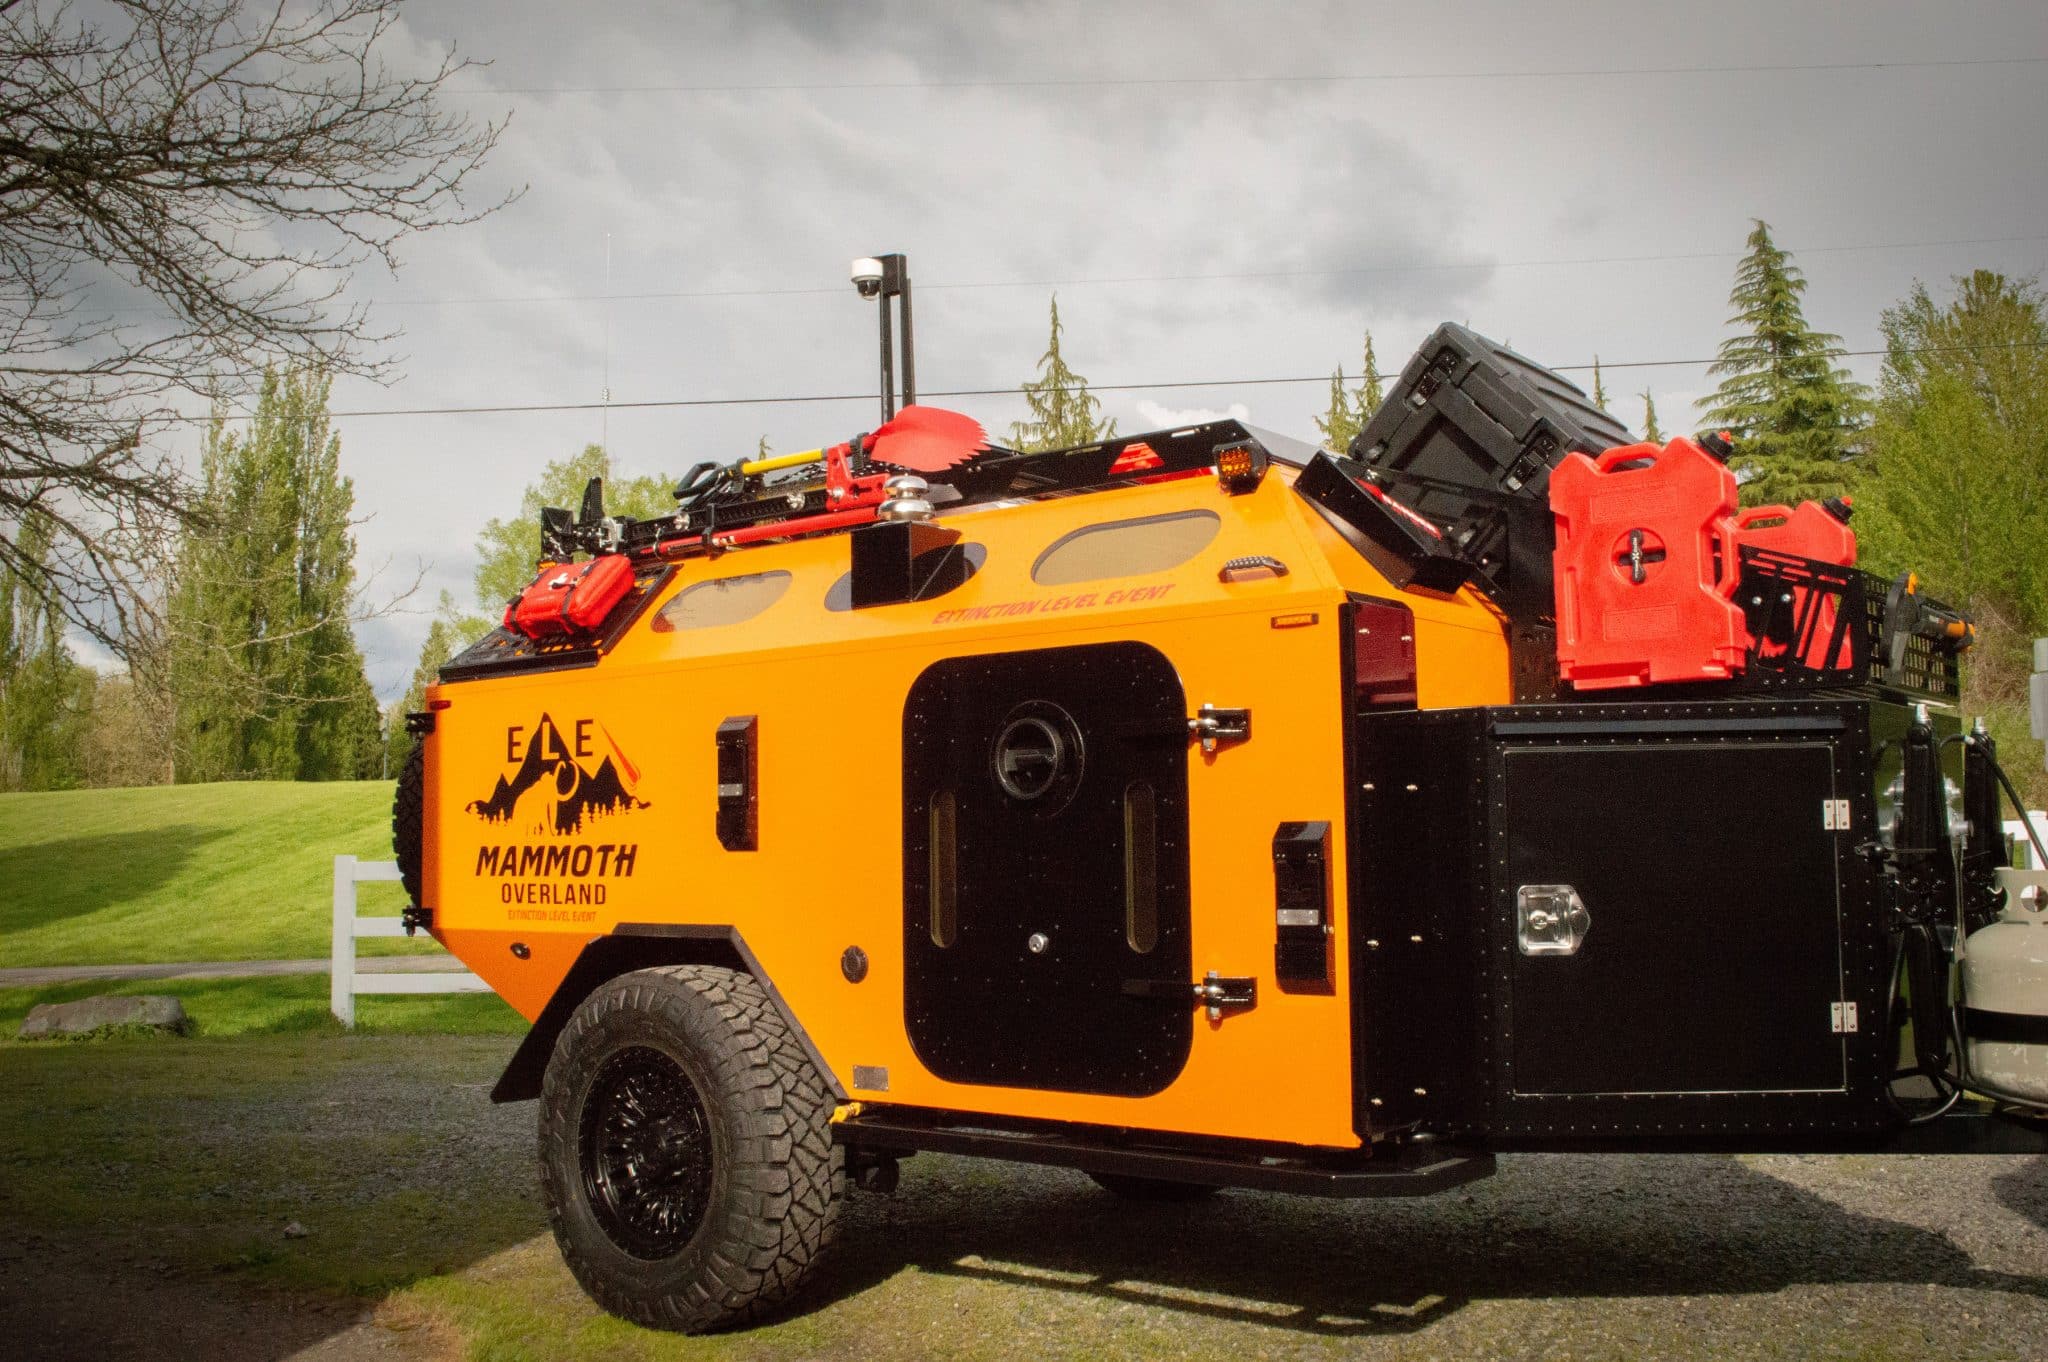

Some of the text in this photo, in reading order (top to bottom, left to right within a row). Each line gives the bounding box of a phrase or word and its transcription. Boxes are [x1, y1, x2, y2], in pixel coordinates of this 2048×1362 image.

[932, 583, 1176, 625] EXTINCTION LEVEL EVENT
[507, 719, 594, 763] ELE
[475, 844, 638, 877] MAMMOTH
[501, 882, 606, 905] OVERLAND
[508, 909, 597, 923] EXTINCTION LEVEL EVENT
